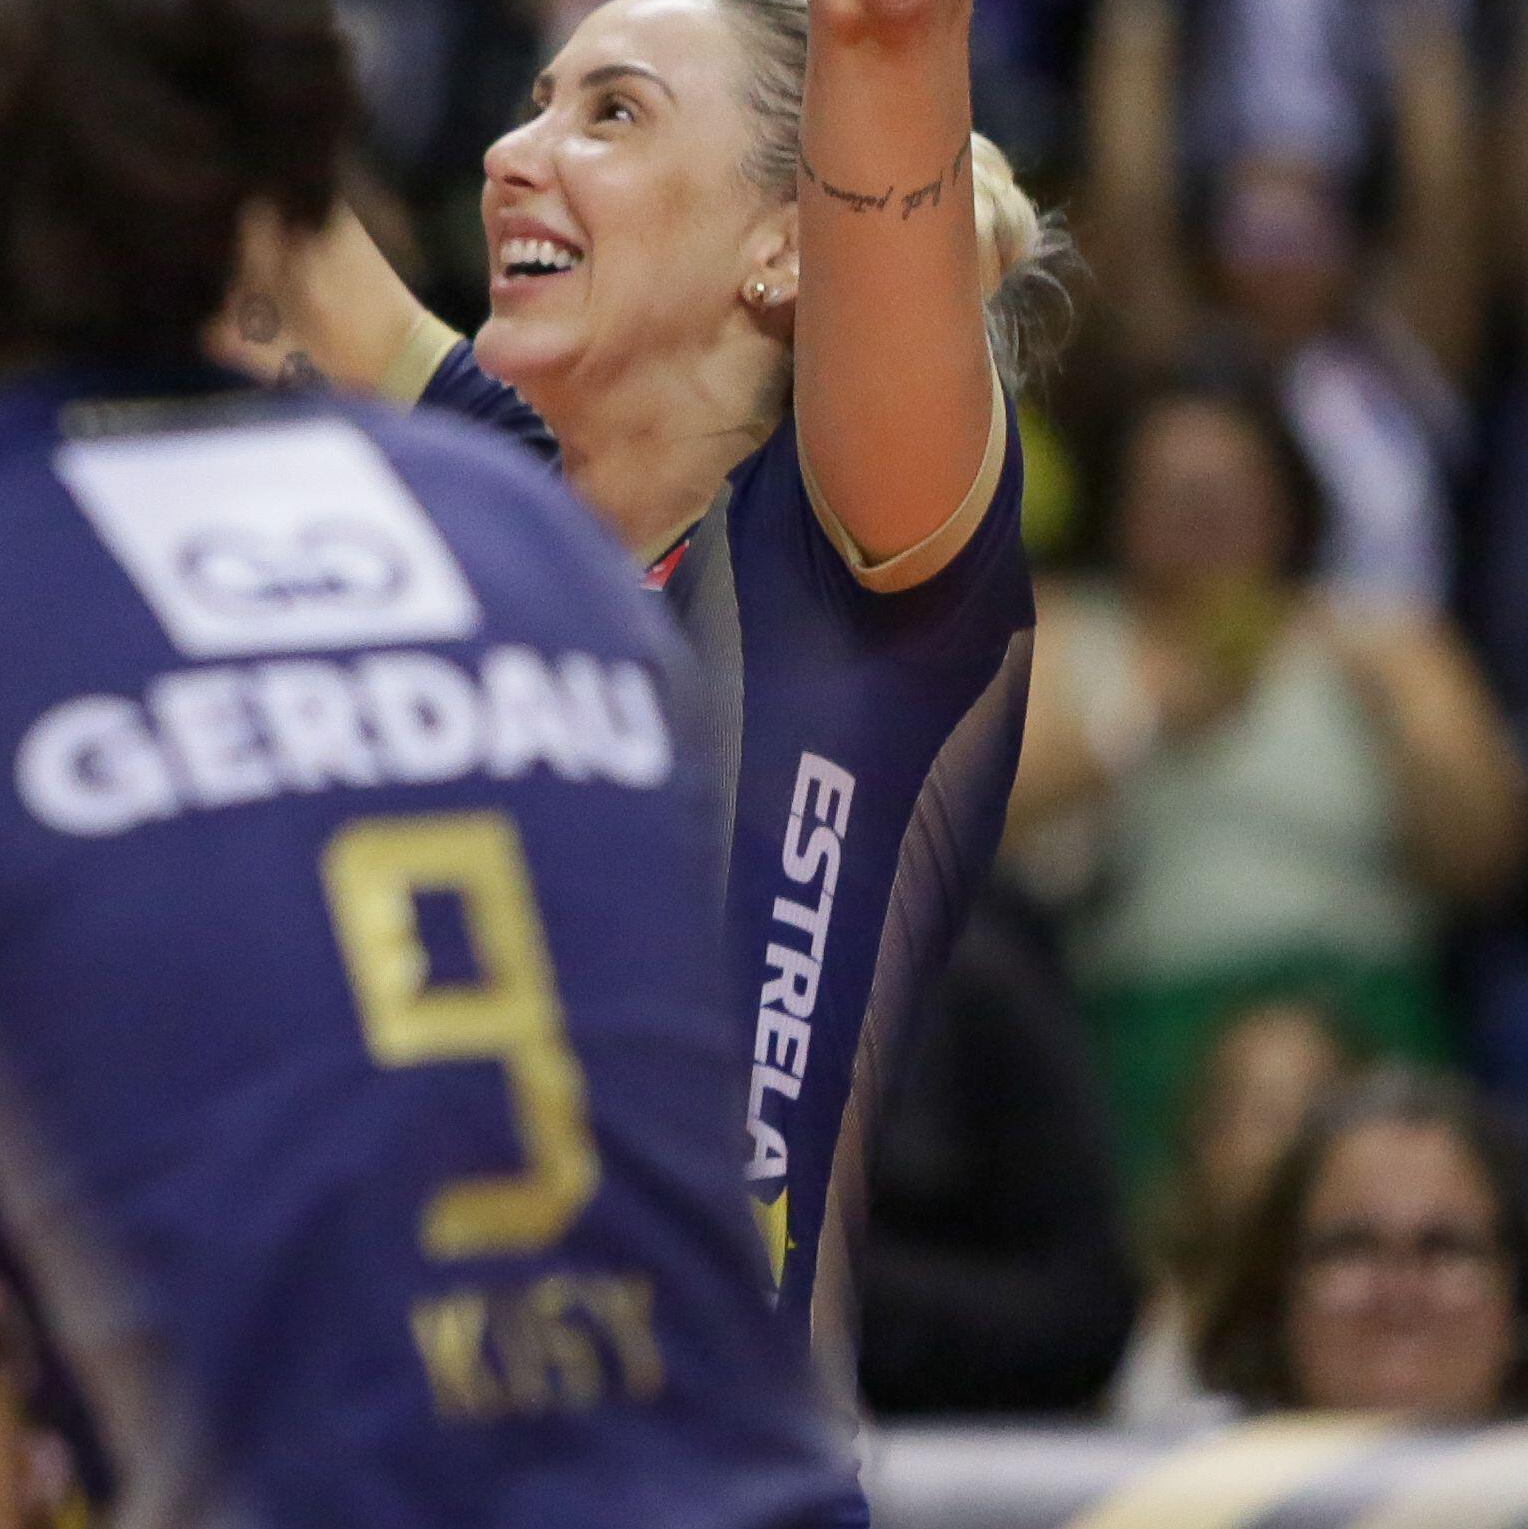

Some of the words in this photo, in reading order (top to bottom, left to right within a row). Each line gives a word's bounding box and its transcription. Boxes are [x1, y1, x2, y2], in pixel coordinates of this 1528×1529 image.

[11, 640, 677, 842] GERDAU
[317, 807, 605, 1266] 9
[743, 750, 857, 1181] ESTRELA
